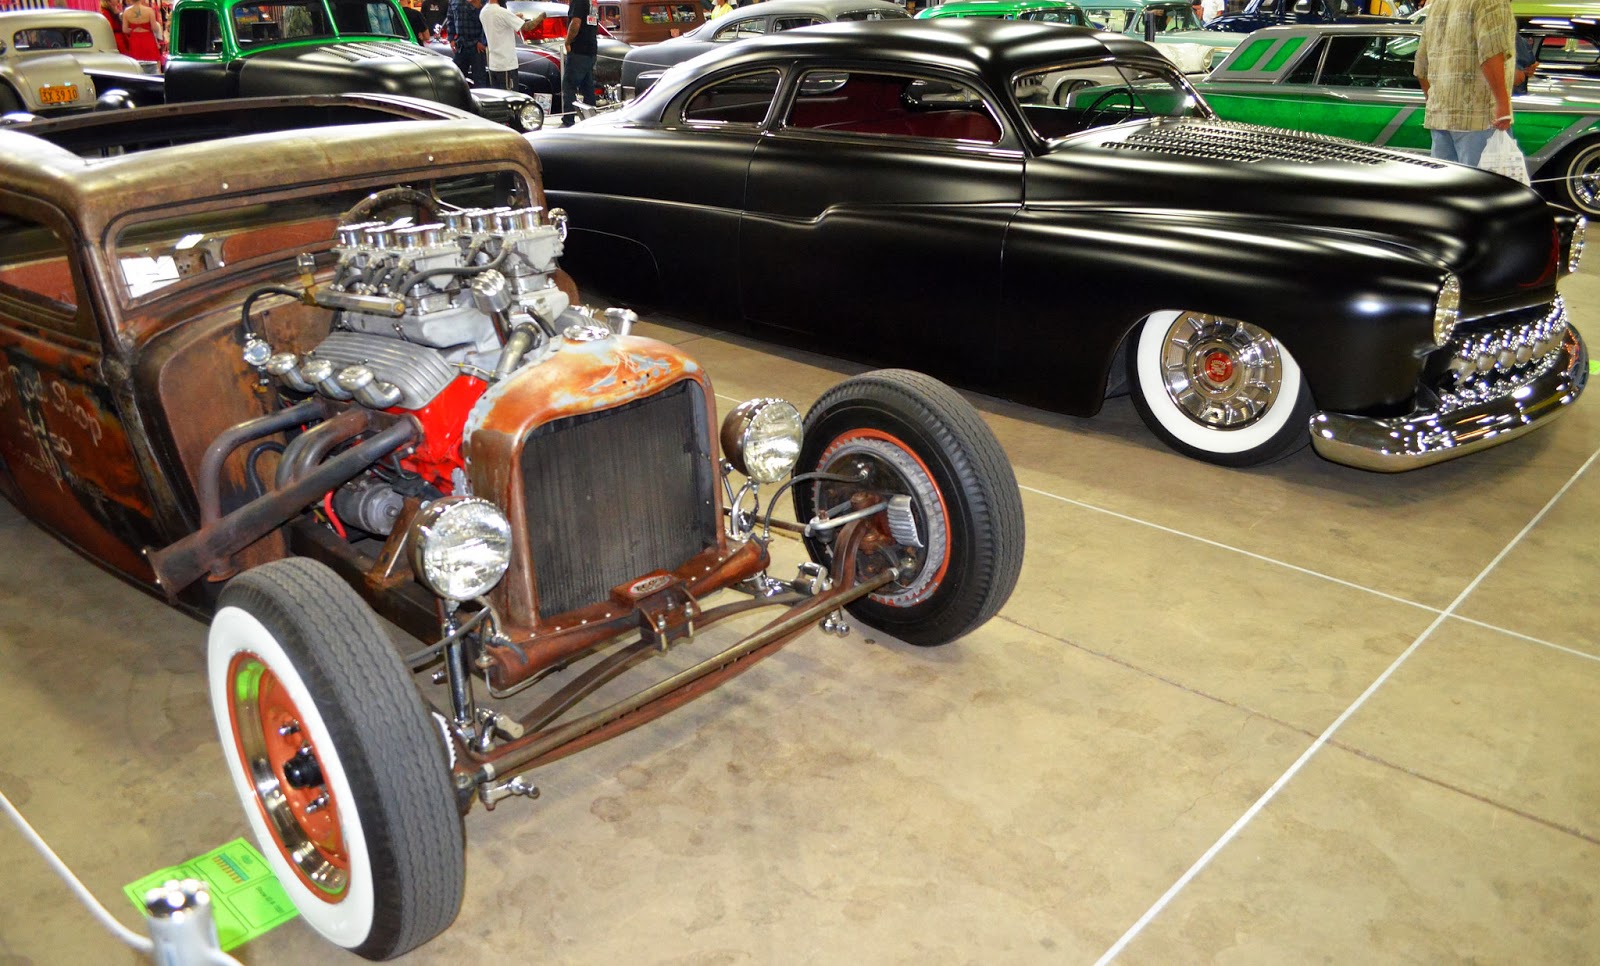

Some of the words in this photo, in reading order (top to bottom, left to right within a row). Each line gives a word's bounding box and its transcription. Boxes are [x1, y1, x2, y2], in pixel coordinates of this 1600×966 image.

[56, 90, 65, 101] 39
[67, 89, 78, 100] 10
[51, 380, 103, 447] Shop
